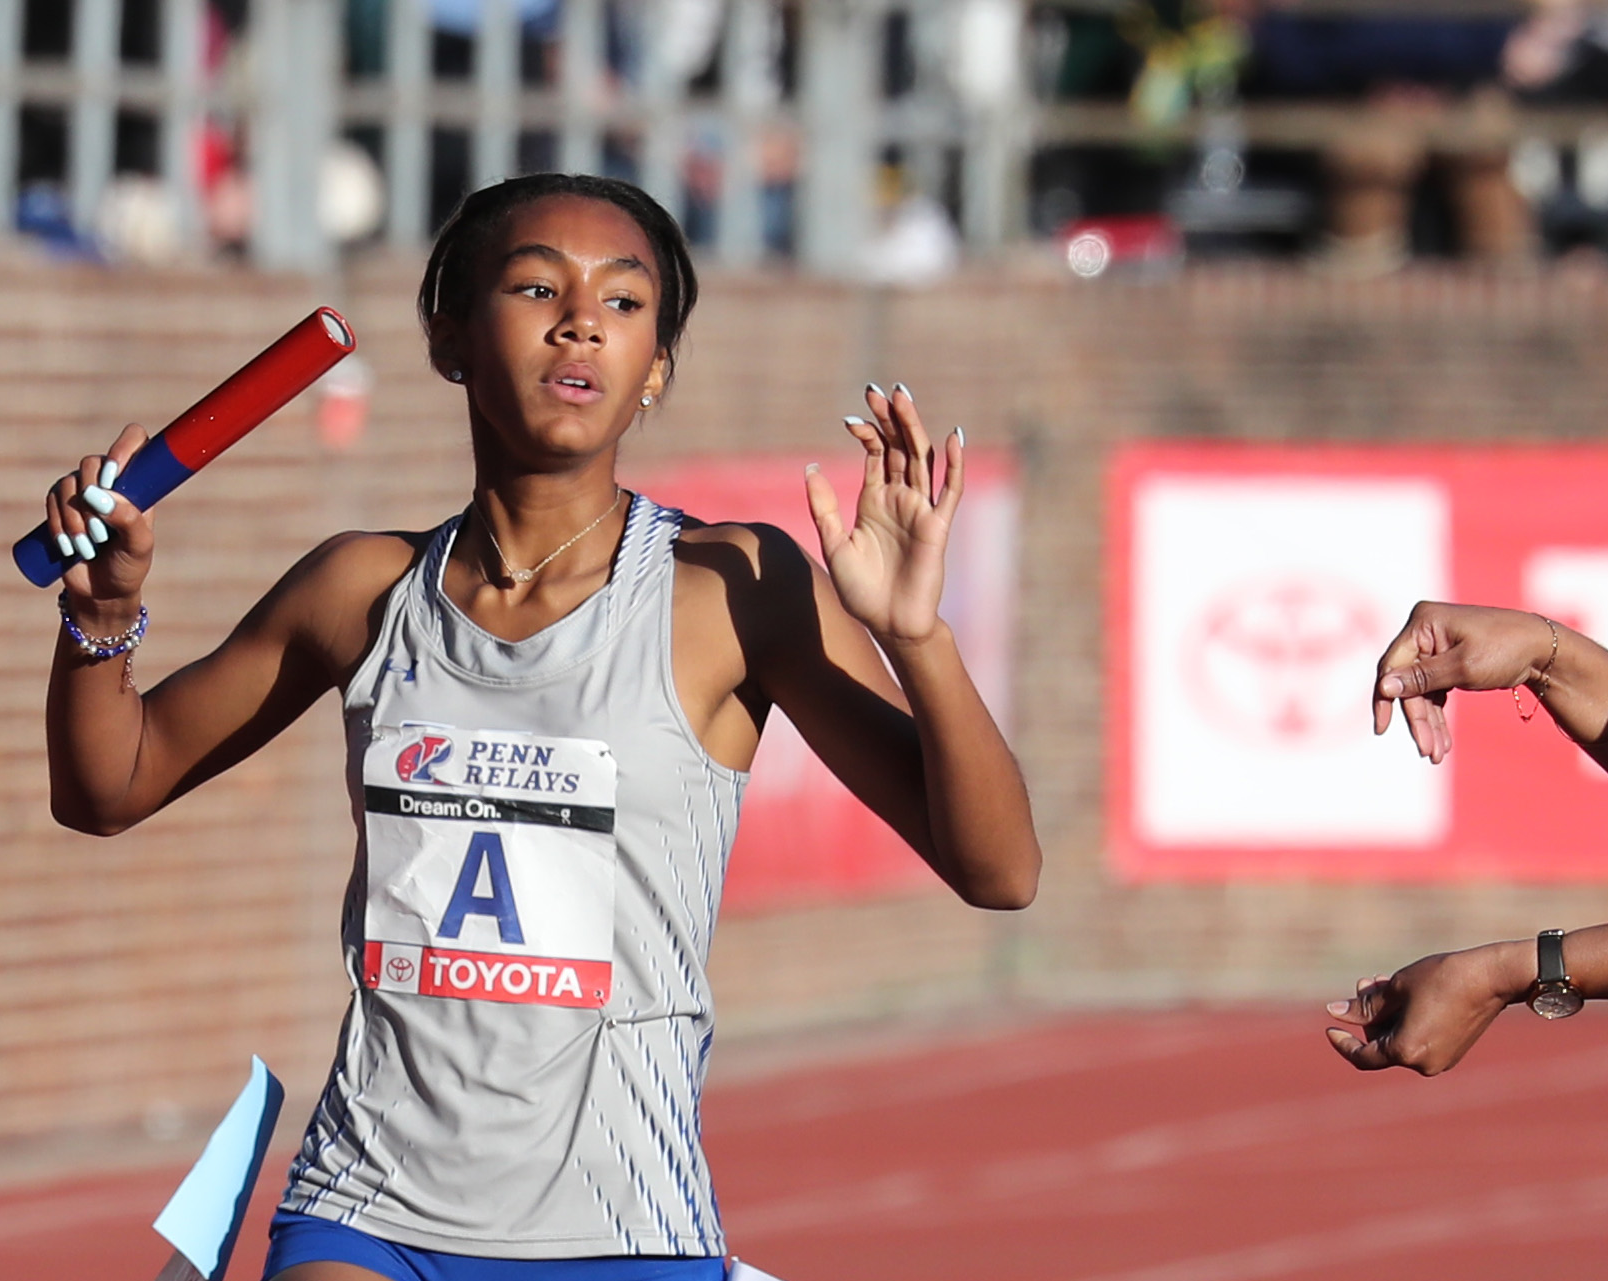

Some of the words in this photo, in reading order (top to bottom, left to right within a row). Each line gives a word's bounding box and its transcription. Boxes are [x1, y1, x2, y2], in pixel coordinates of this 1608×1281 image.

[467, 740, 556, 768] PENN
[462, 764, 581, 794] RELAYS
[399, 794, 462, 818] Dream
[464, 798, 503, 820] On.
[435, 830, 526, 945] A
[428, 955, 583, 998] TOYOTA
